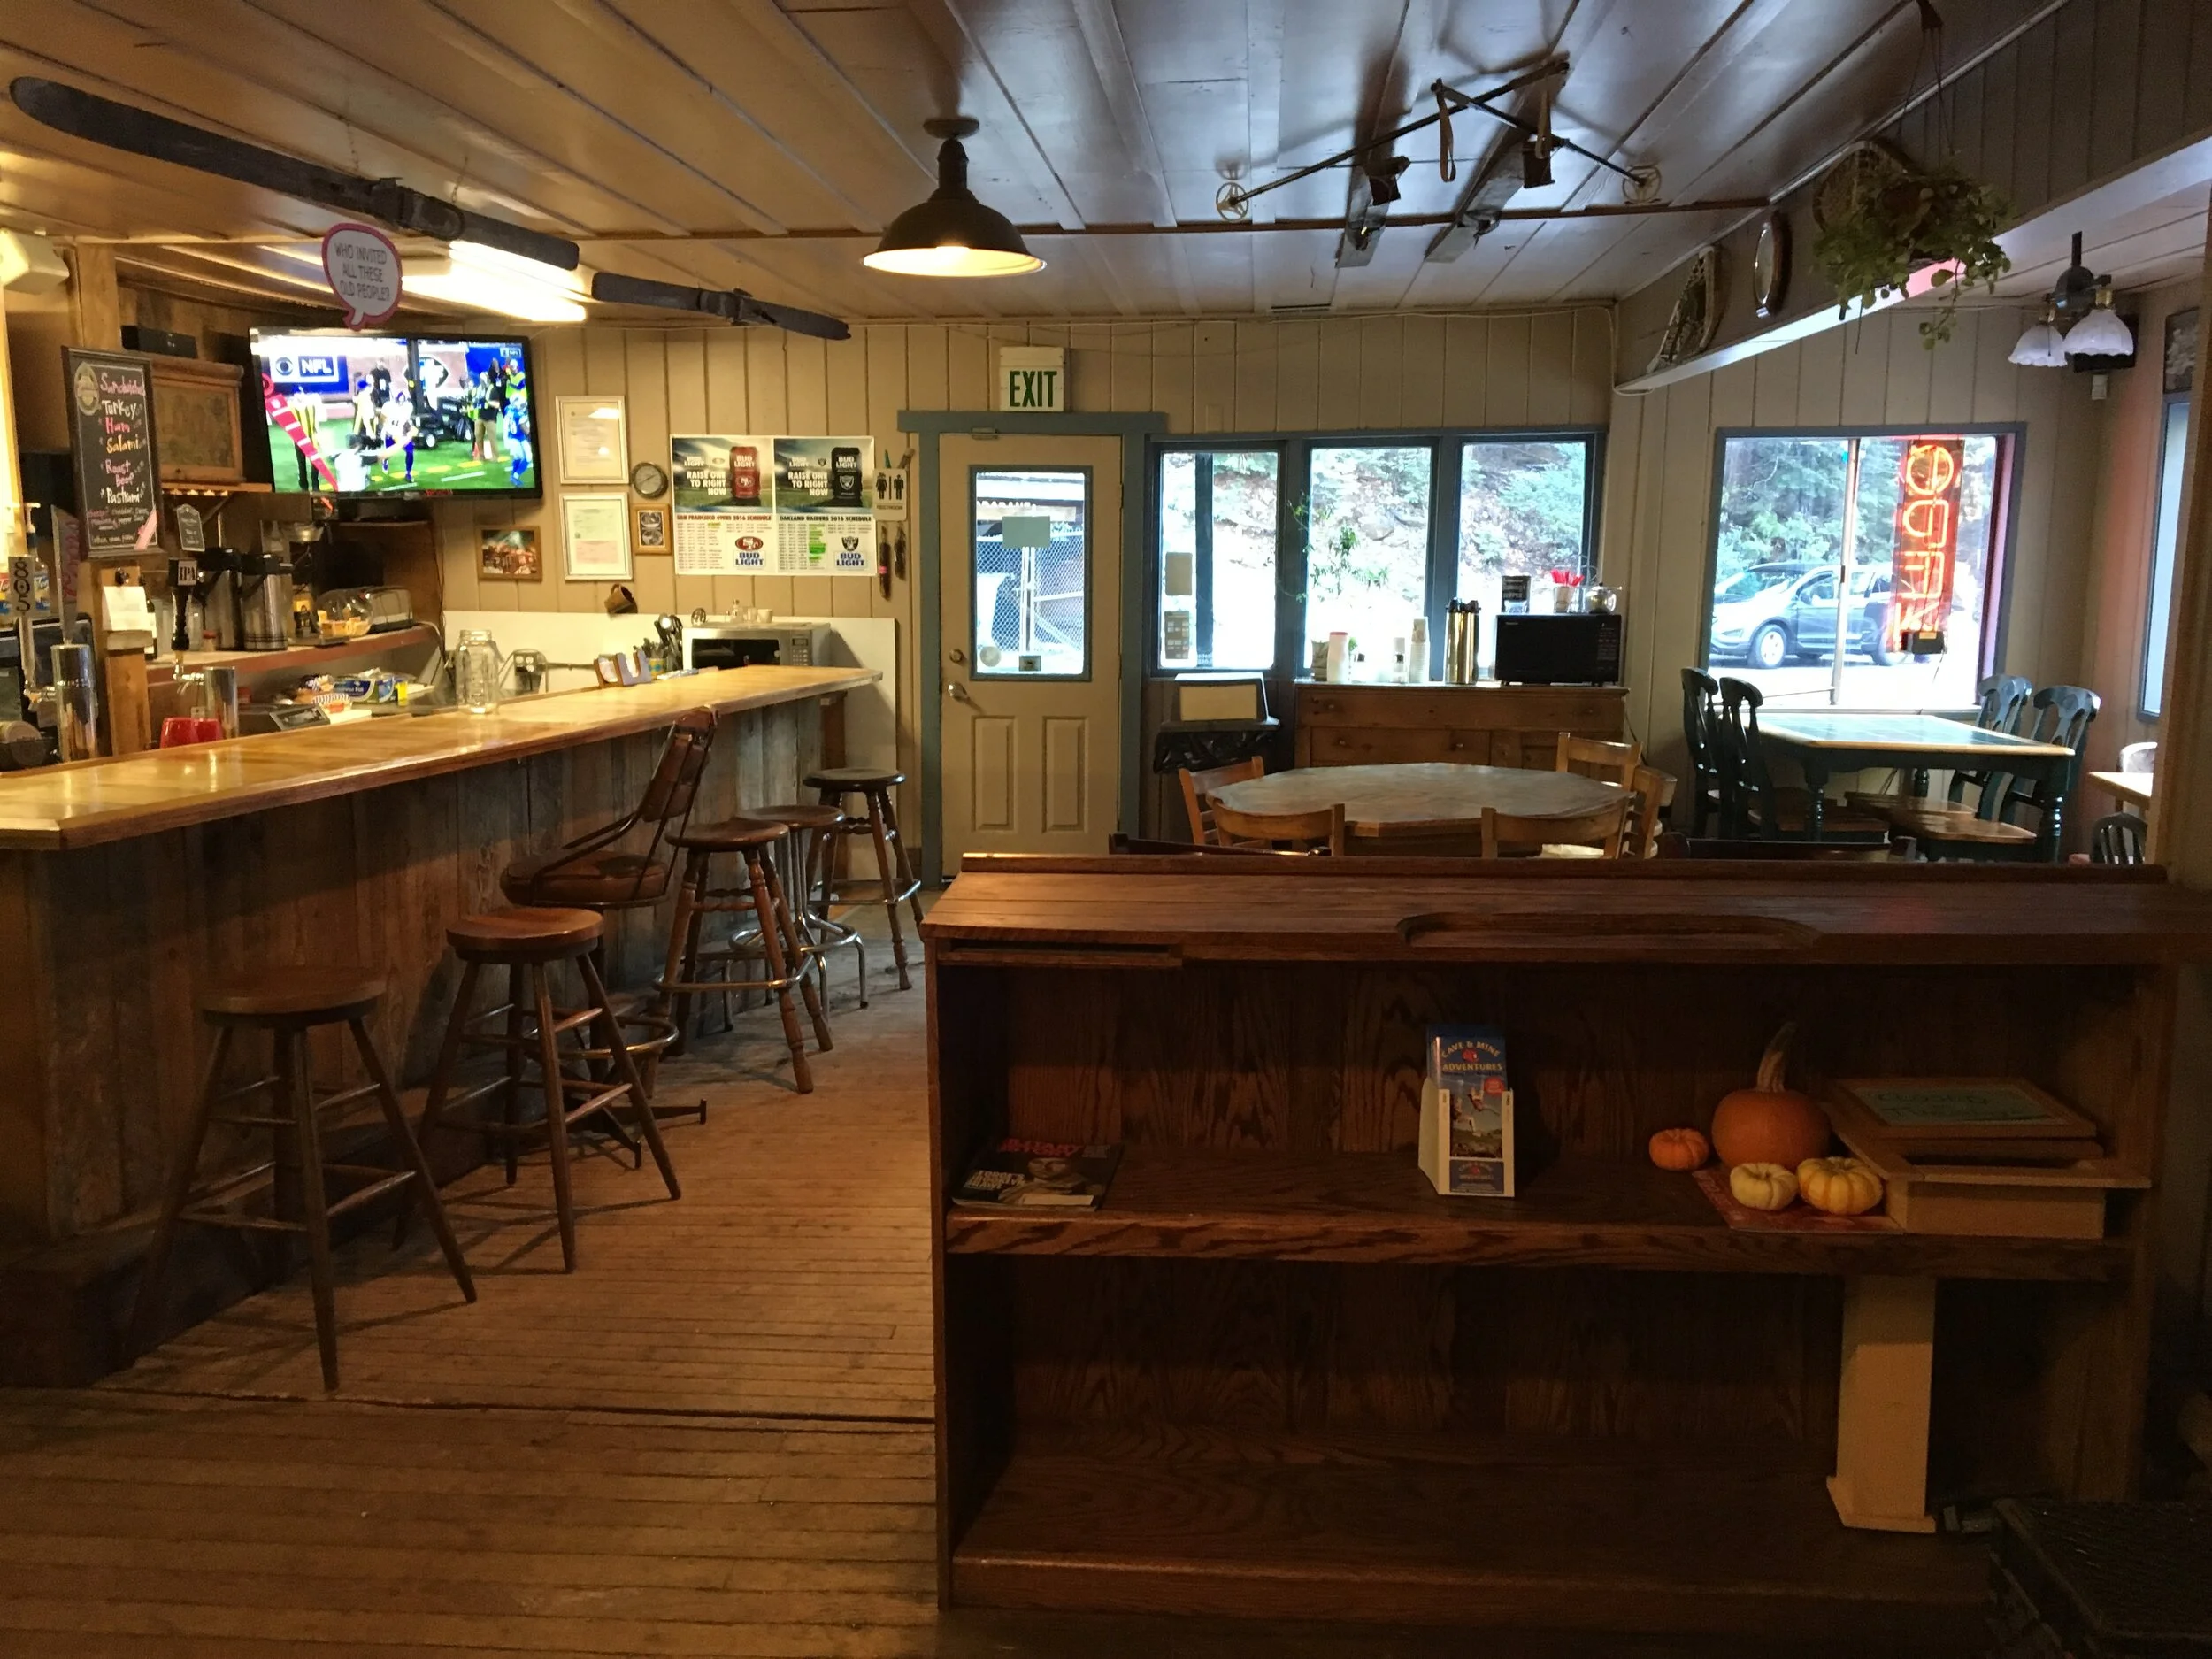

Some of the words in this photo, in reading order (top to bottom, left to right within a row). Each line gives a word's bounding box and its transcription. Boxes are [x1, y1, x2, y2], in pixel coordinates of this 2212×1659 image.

[334, 243, 354, 259] WHO
[356, 246, 388, 265] INVITED
[342, 263, 357, 279] ALL
[358, 265, 384, 283] THESE
[340, 280, 355, 296] OLD
[357, 283, 390, 302] PEOPLE?
[302, 358, 332, 374] NFL
[1010, 370, 1057, 407] EXIT
[102, 399, 136, 420] Turkey
[105, 417, 131, 434] Ham
[106, 434, 140, 454] Salami
[105, 458, 131, 474] Roast
[687, 470, 709, 479] RAISE
[115, 472, 134, 487] Beef
[703, 479, 726, 488] RIGHT
[787, 471, 810, 480] RAISE
[106, 486, 140, 504] Pastrami
[179, 565, 196, 581] IPA
[14, 561, 31, 612] 805
[1441, 1041, 1463, 1058] CAVE
[1476, 1041, 1501, 1058] MINE
[1442, 1063, 1502, 1071] ADVENTURES
